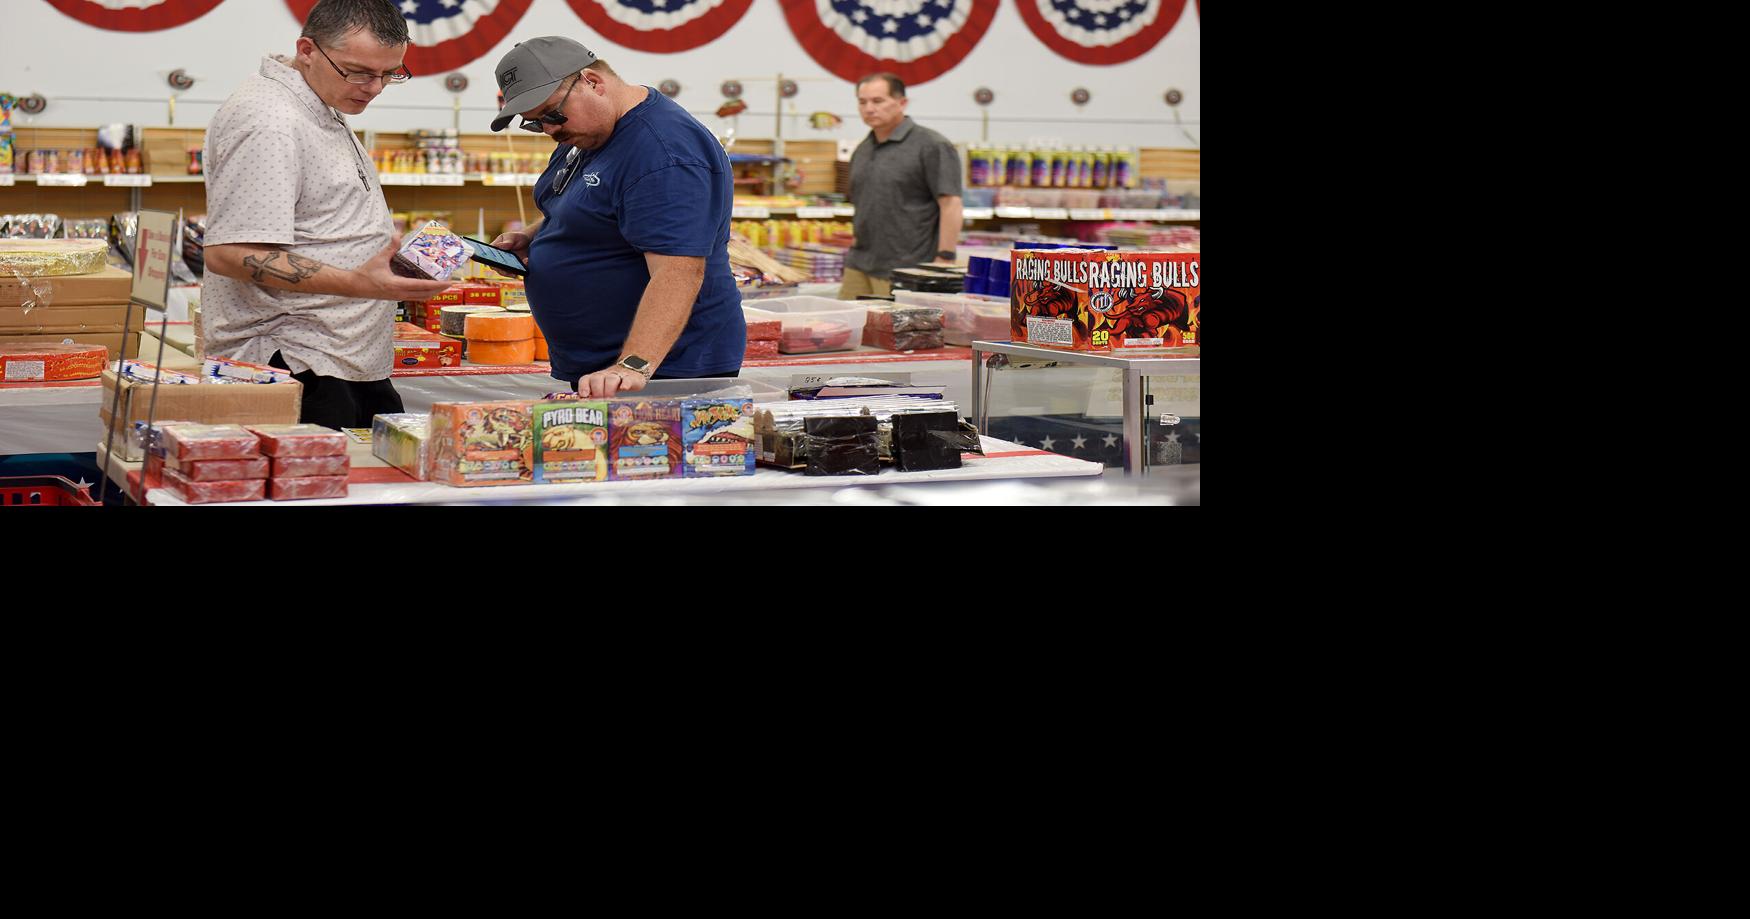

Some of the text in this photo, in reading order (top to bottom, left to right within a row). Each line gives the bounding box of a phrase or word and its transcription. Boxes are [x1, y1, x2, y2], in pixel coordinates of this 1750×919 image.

[1016, 258, 1088, 284] RAGING BULLS
[1089, 261, 1199, 288] RAGING BULLS
[1092, 330, 1109, 341] 20
